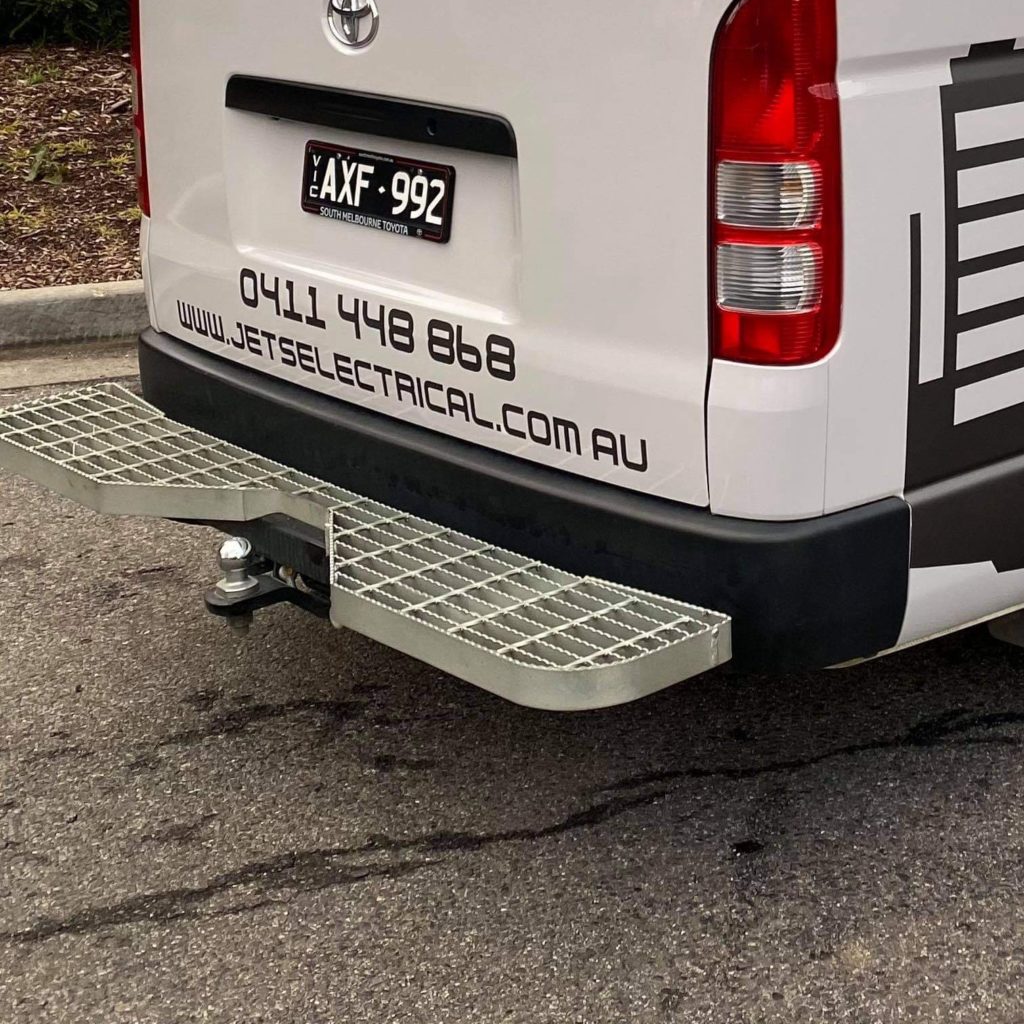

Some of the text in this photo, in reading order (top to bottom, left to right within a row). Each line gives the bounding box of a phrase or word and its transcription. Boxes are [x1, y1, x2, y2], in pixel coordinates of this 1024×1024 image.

[309, 154, 322, 198] VIC
[320, 157, 446, 226] AXF 992
[320, 206, 409, 236] SOUTH MELBOURNE TOYOTA
[239, 268, 516, 382] 0411 448 868
